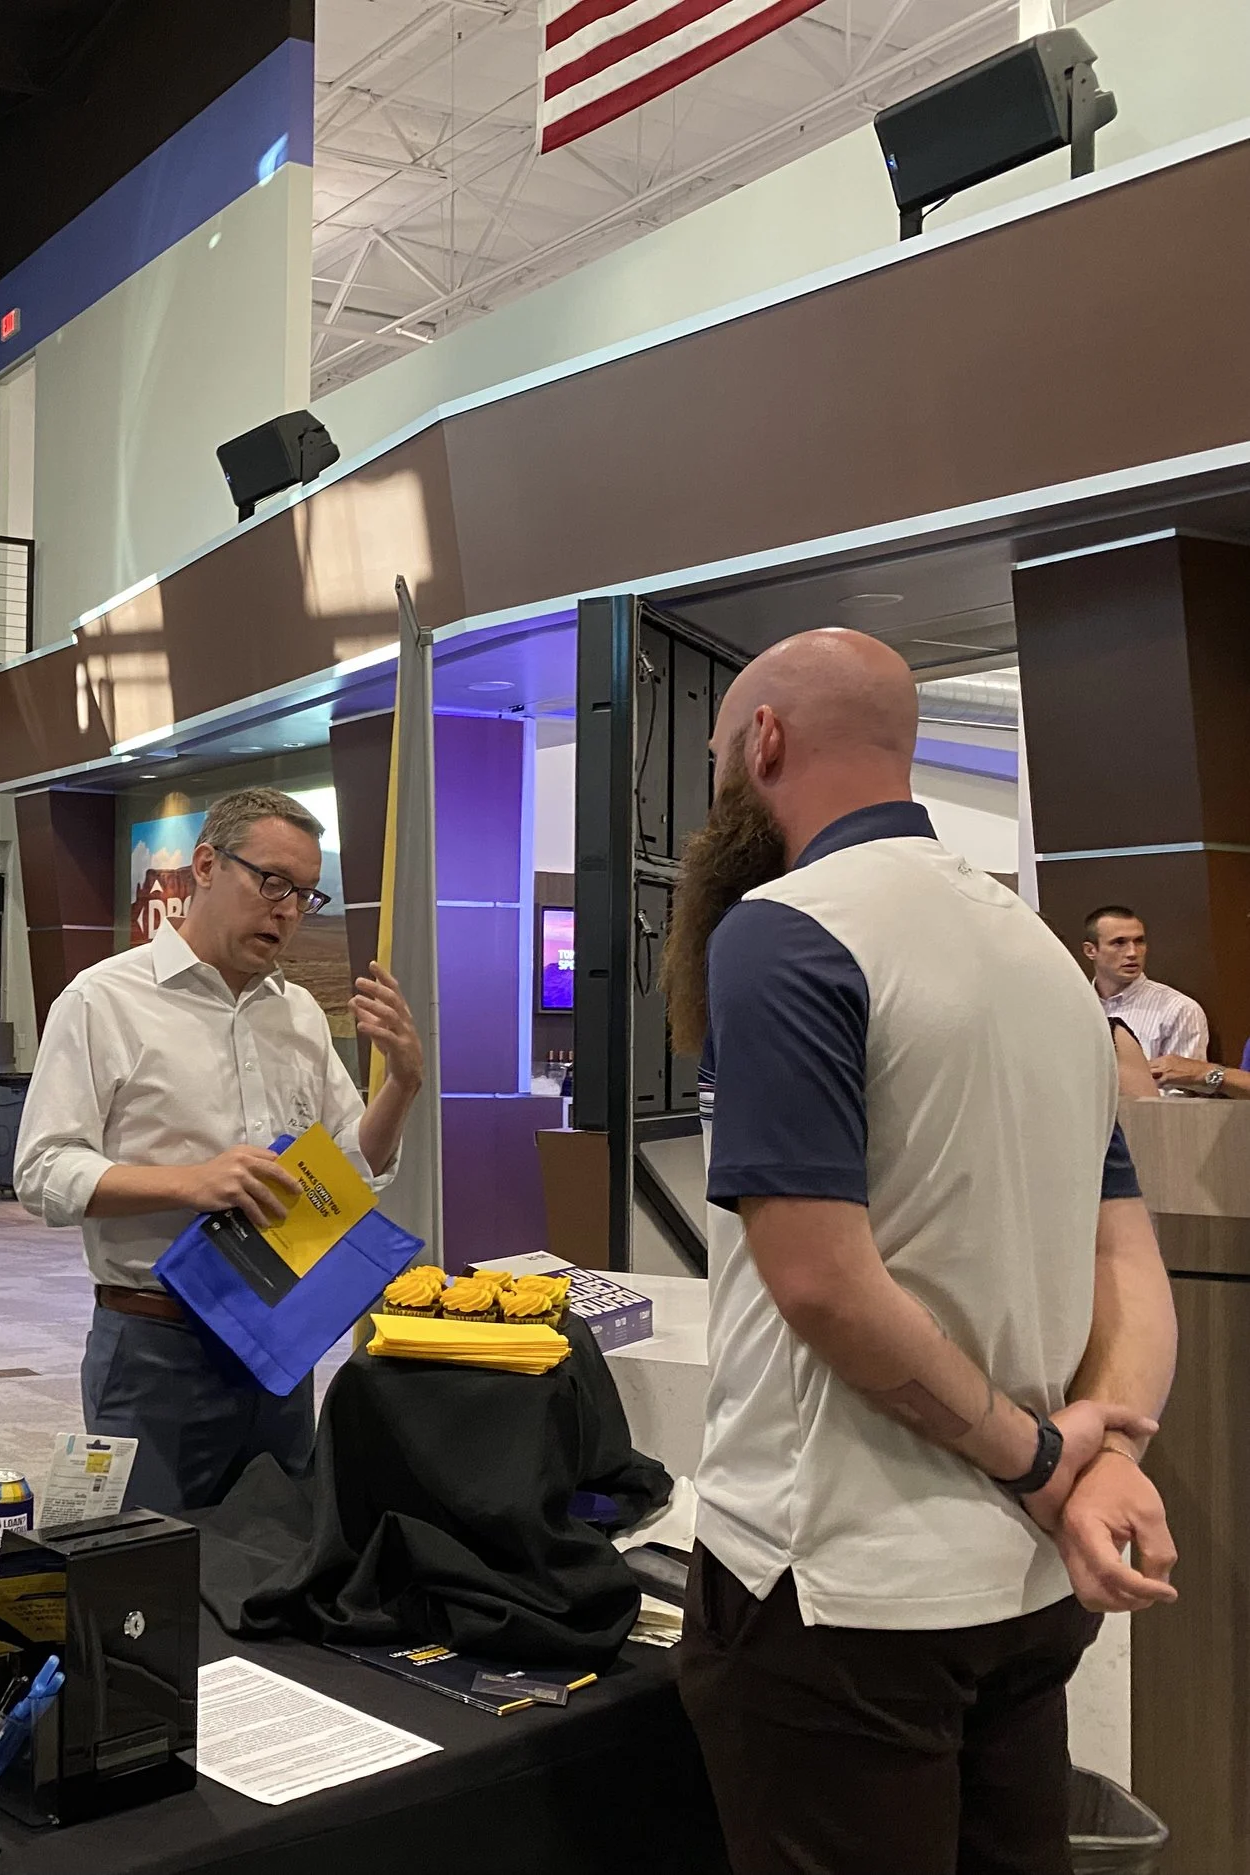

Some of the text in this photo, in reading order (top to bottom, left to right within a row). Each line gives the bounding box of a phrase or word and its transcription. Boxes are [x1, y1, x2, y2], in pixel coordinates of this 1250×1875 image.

[297, 1160, 342, 1216] BANKS OWN YOU
[298, 1176, 330, 1218] YOU OWN US
[559, 1268, 599, 1285] KIT
[566, 1279, 621, 1303] CENTE
[569, 1289, 648, 1319] IDEATION
